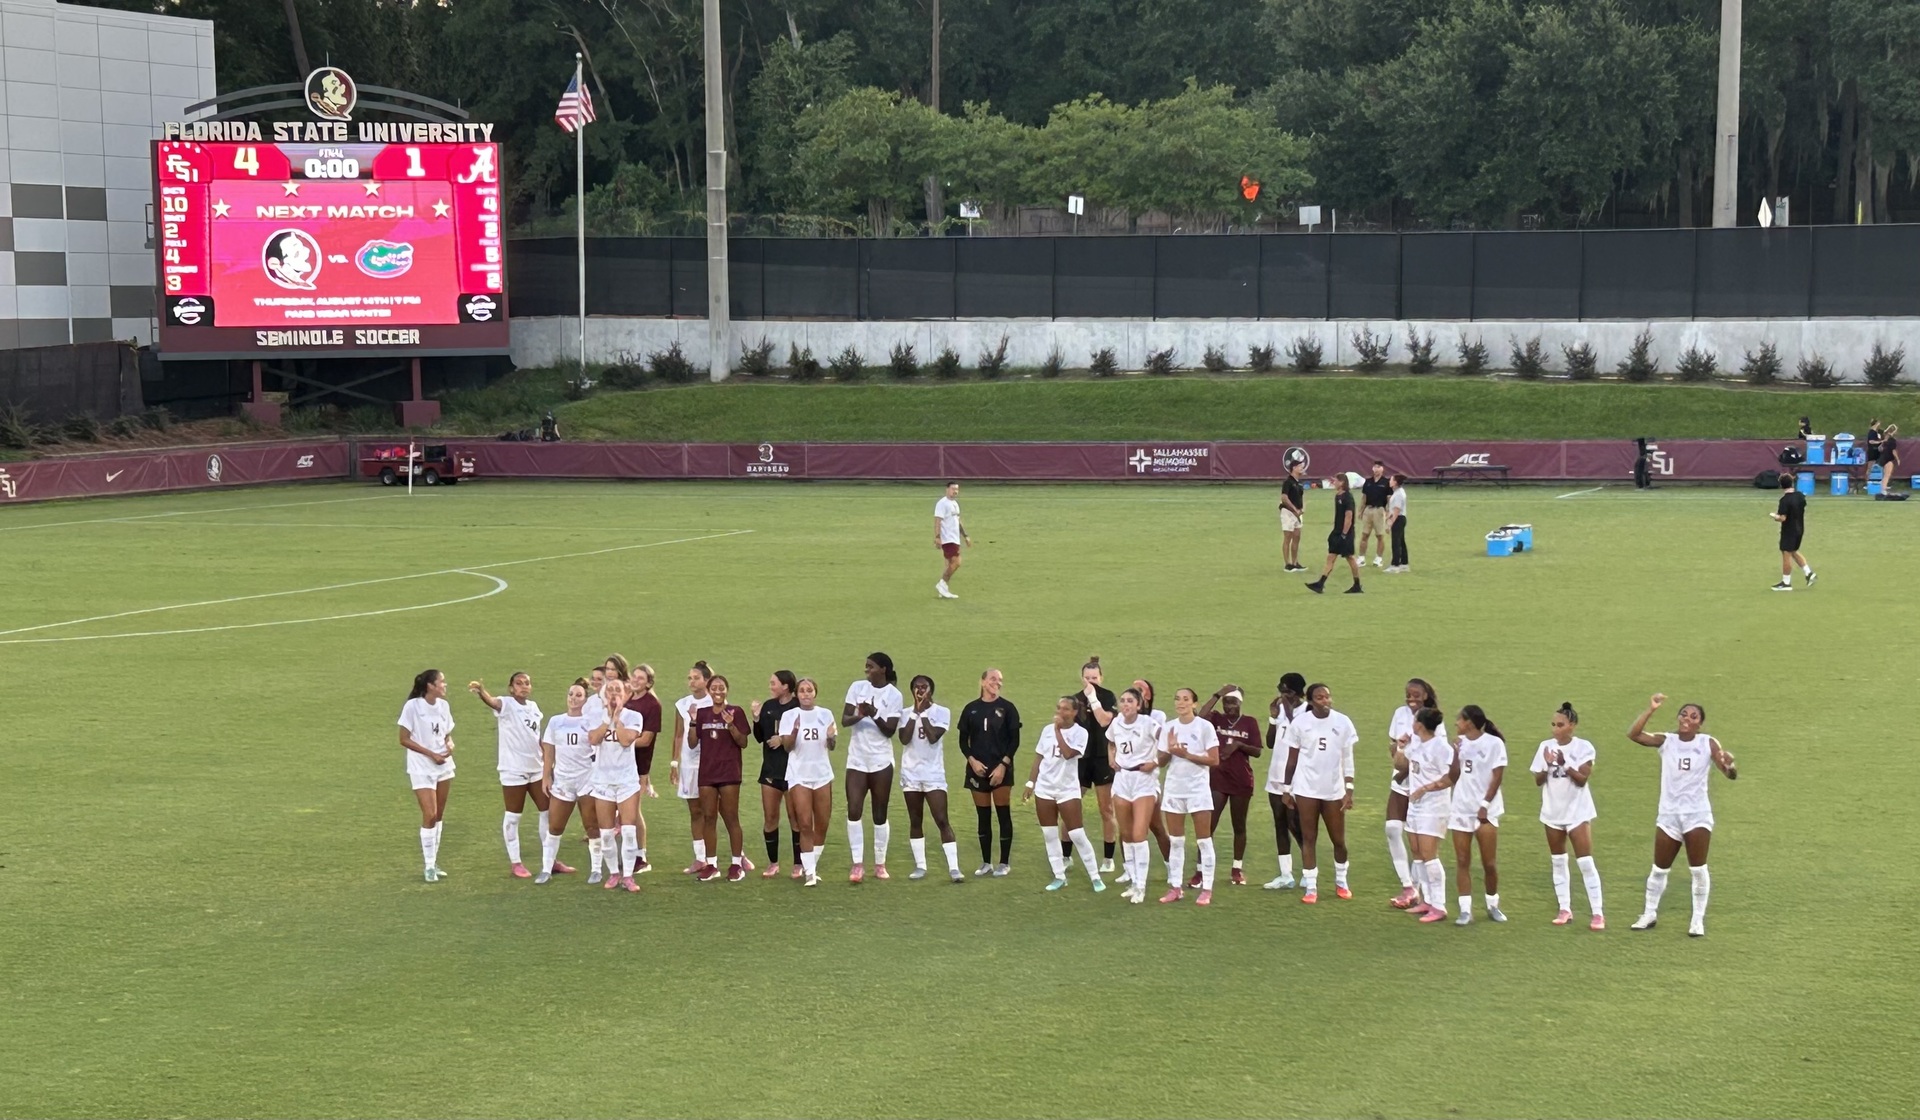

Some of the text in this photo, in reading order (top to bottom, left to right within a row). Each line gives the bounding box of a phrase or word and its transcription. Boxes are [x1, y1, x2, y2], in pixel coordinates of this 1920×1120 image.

[164, 121, 494, 143] FLORIDA STATE UNIVERSITY
[234, 147, 260, 176] 4
[304, 158, 360, 179] 0:00
[406, 147, 426, 177] 1
[163, 196, 188, 213] 10
[483, 196, 497, 213] 4
[256, 205, 414, 219] NEXT MATCH
[164, 223, 179, 239] 2
[166, 248, 180, 264] 4
[167, 275, 182, 291] 3
[403, 296, 421, 305] PM
[256, 329, 420, 346] SEMINOLE SOCCER
[1152, 448, 1208, 457] TALLAHASSEE
[1454, 453, 1491, 464] ACC
[1153, 457, 1197, 466] MEMORIAL
[431, 721, 440, 735] 14
[983, 717, 988, 732] 1
[567, 733, 578, 745] 10
[803, 728, 819, 740] 28
[1121, 741, 1133, 754] 21
[1318, 737, 1327, 751] 5
[1464, 759, 1473, 773] 9
[1678, 758, 1691, 770] 19
